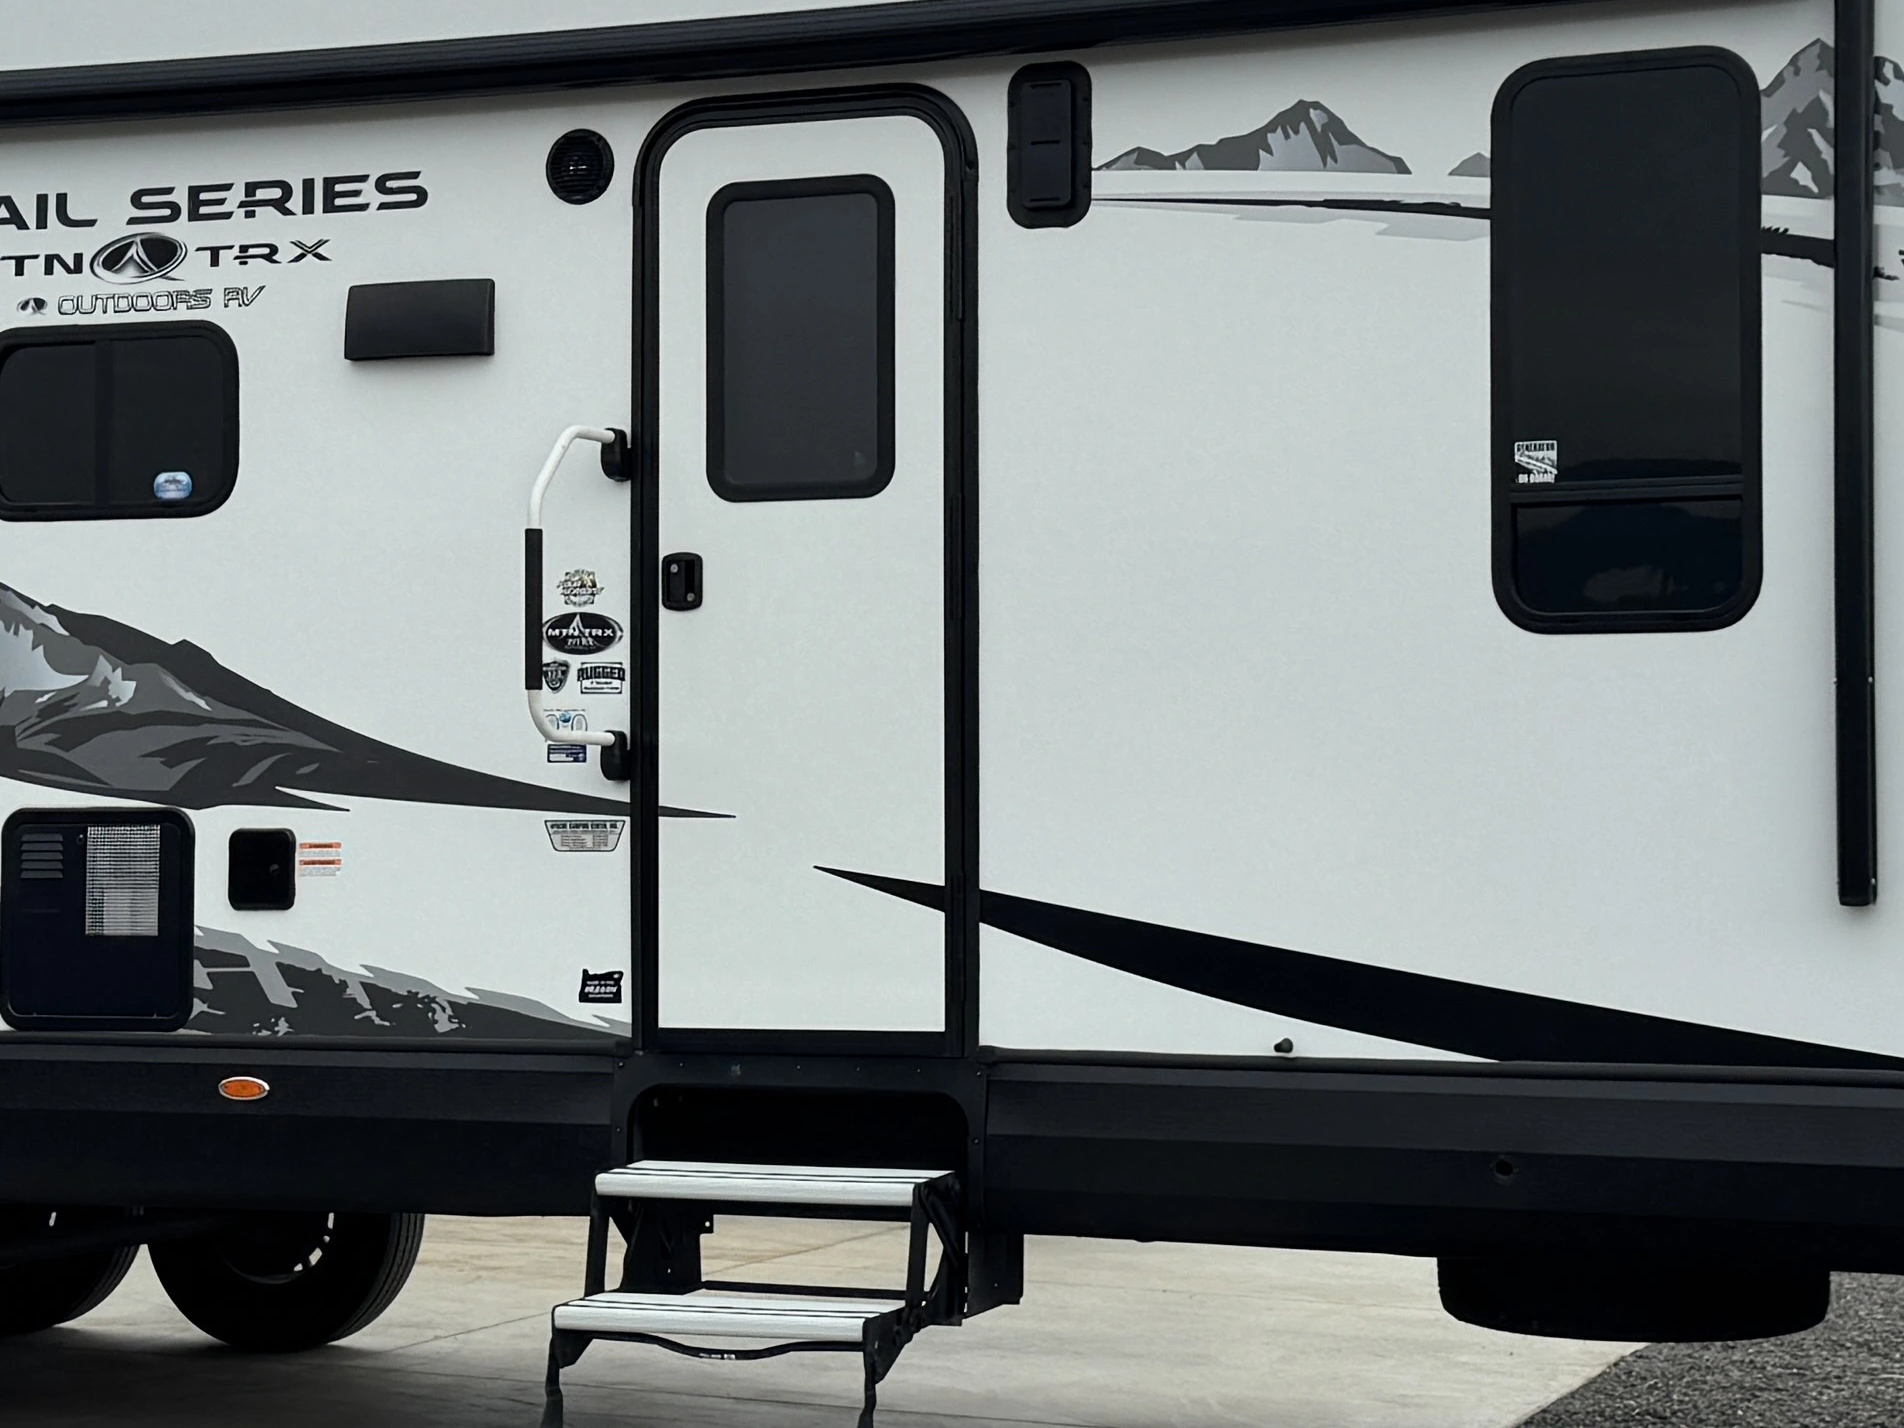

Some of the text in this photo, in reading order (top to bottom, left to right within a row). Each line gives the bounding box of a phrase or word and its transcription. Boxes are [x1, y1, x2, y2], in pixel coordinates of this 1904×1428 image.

[125, 170, 429, 226] SERIES
[194, 238, 333, 269] TRX
[57, 285, 267, 316] OUTDOORS RV
[577, 665, 626, 682] RUGGED
